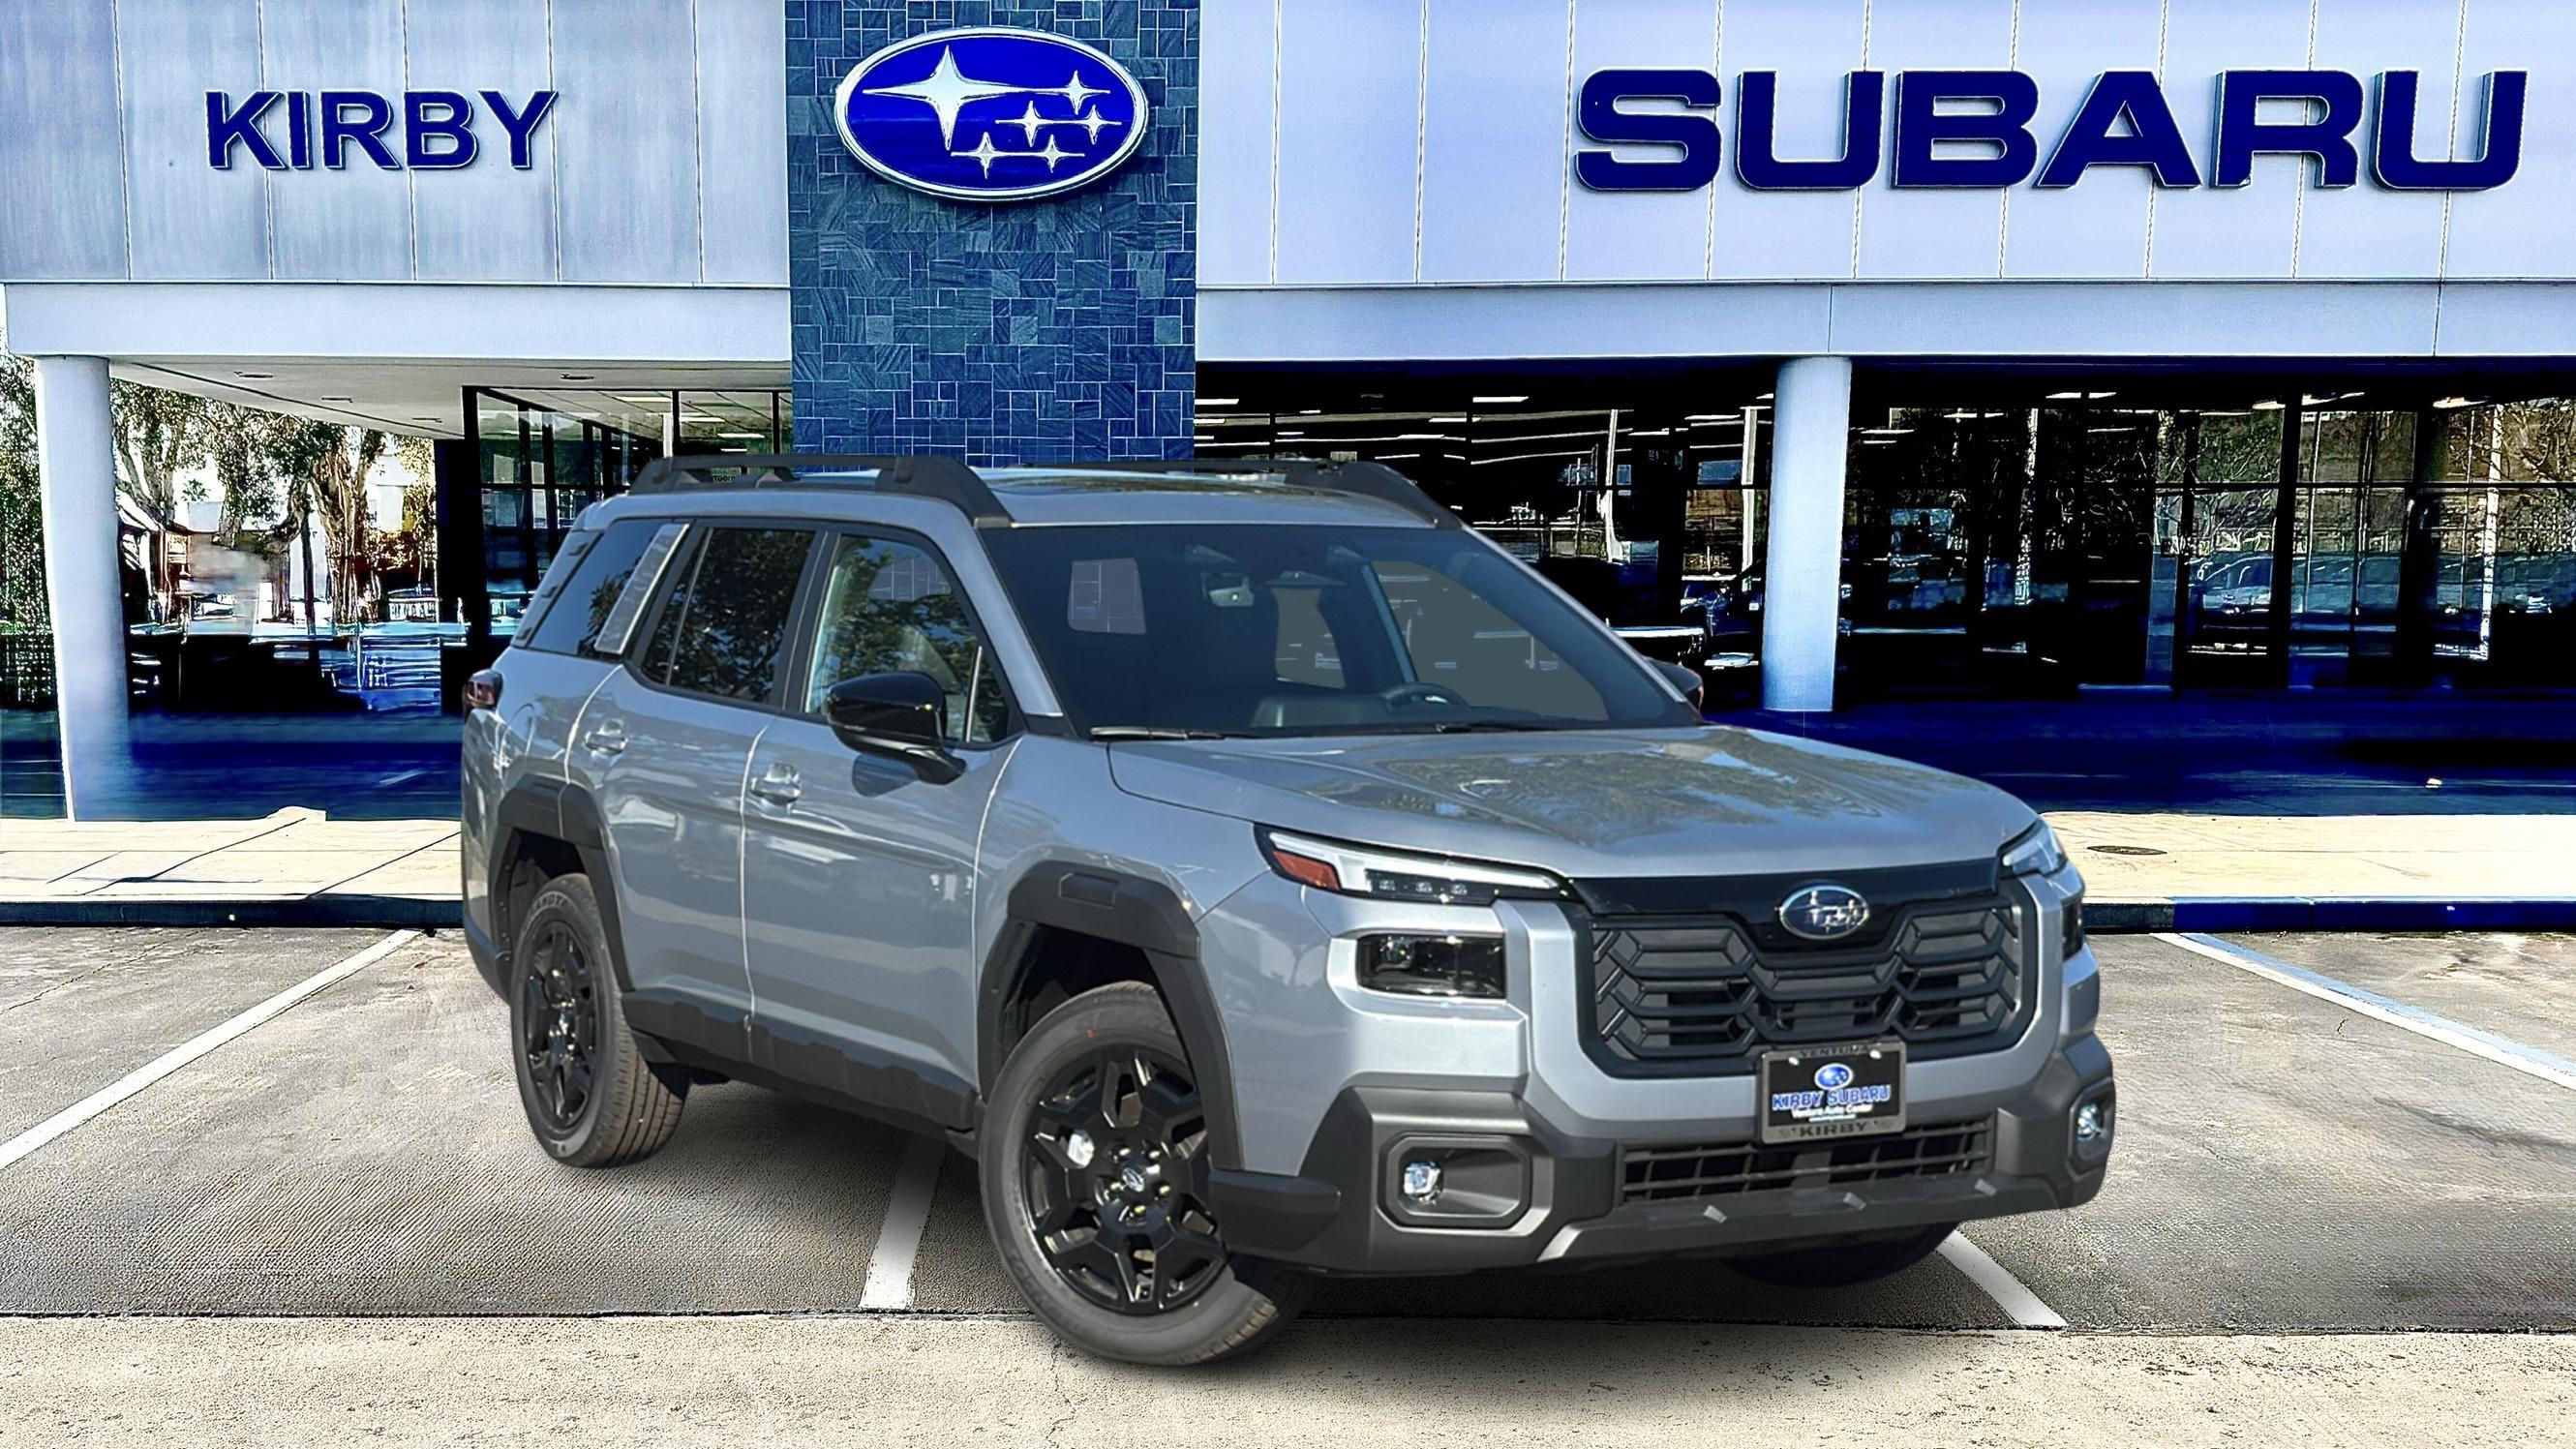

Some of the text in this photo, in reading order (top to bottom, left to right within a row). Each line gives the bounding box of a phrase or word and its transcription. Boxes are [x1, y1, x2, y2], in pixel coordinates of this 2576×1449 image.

[205, 90, 559, 170] KIRBY
[1574, 69, 2529, 194] SUBARU
[1773, 1085, 1891, 1110] KIRBY SUBARU
[1800, 1122, 1867, 1137] KIRBY
